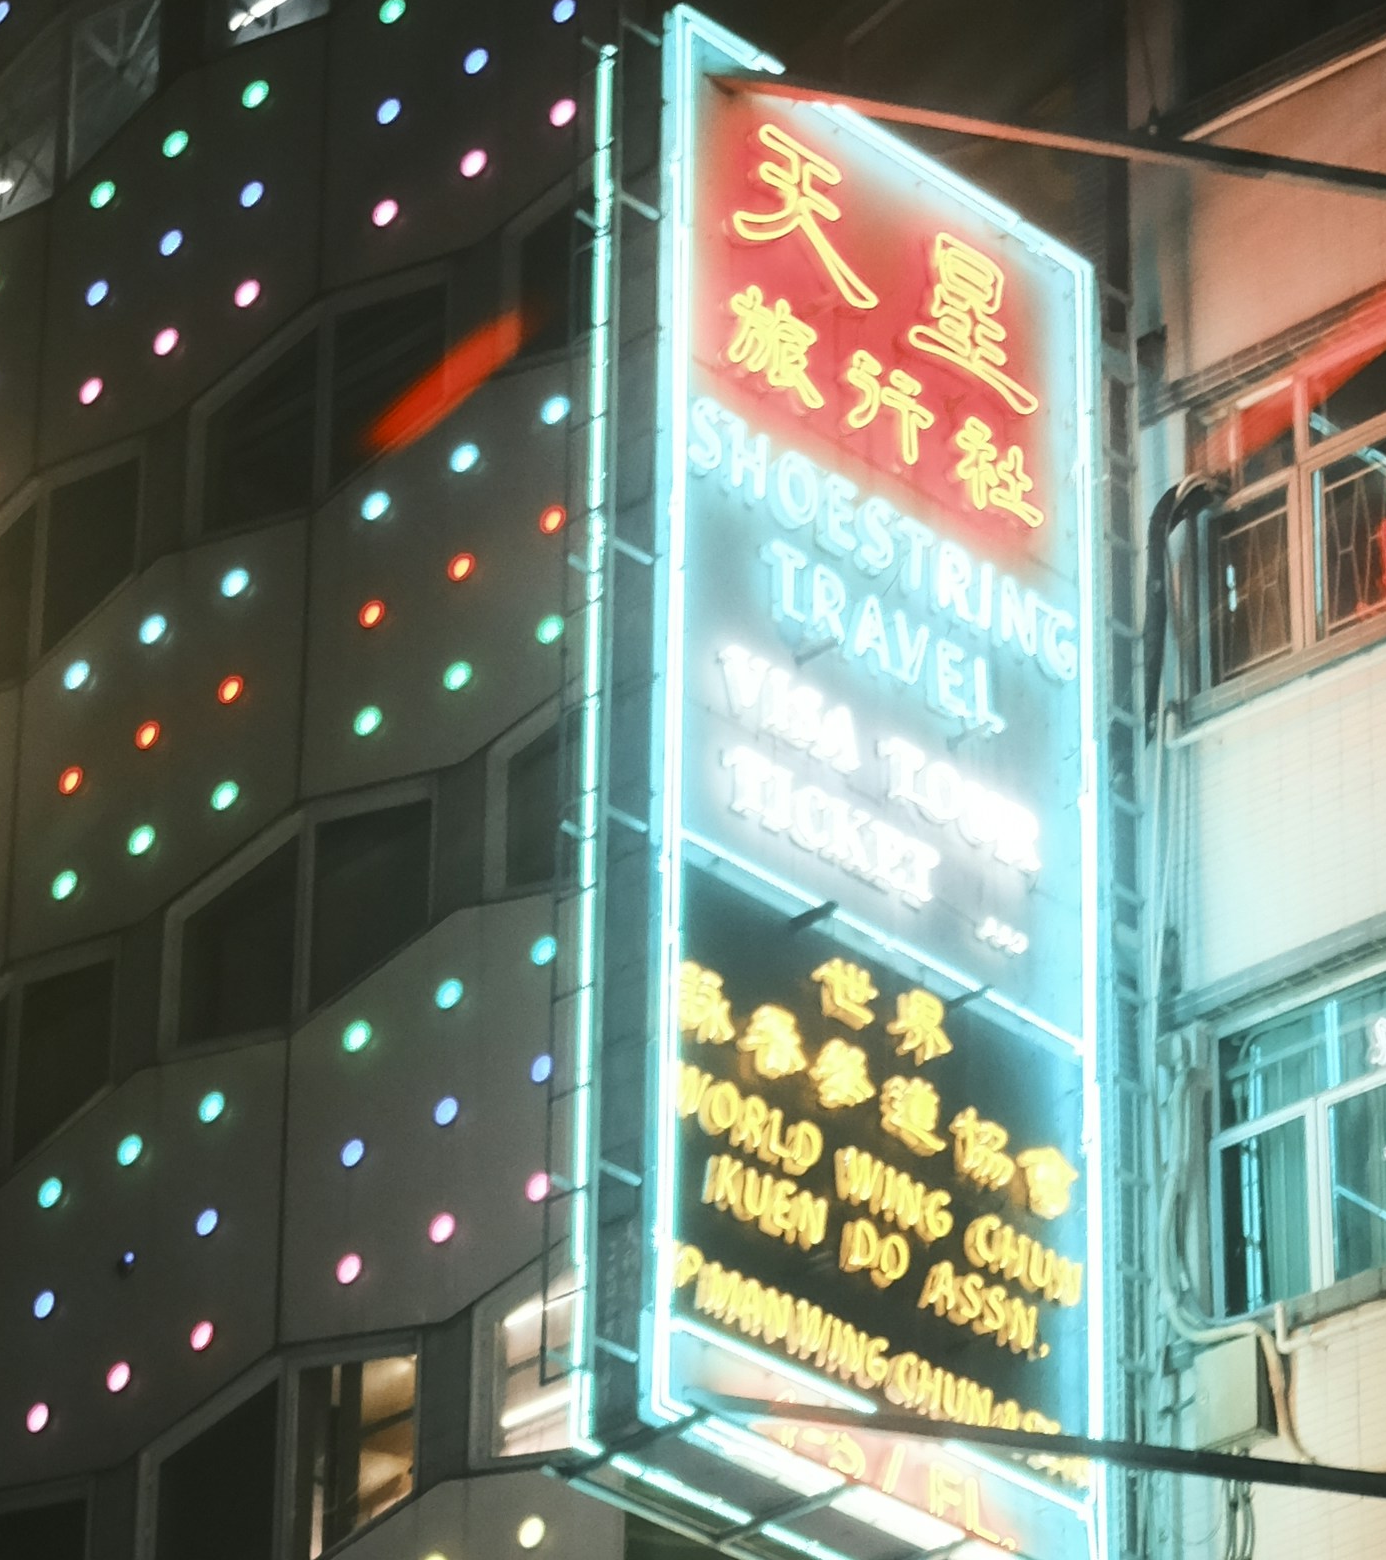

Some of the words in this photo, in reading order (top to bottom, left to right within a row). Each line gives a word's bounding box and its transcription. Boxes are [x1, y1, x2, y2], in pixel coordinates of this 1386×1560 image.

[726, 285, 1044, 529] 旅行社
[687, 396, 1081, 683] SHOESTRING
[762, 538, 1006, 738] TRAVEL
[716, 644, 861, 776] VISA
[876, 737, 1042, 873] TOUR
[720, 745, 941, 909] TICKET
[811, 956, 954, 1066] 世界
[676, 1061, 824, 1176] WORLD
[834, 1145, 954, 1241] WING
[964, 1213, 1083, 1307] CHUN
[701, 1153, 829, 1250] KUEN
[840, 1218, 911, 1289] DO
[788, 1298, 889, 1389] WING
[885, 1352, 995, 1428] CHUN
